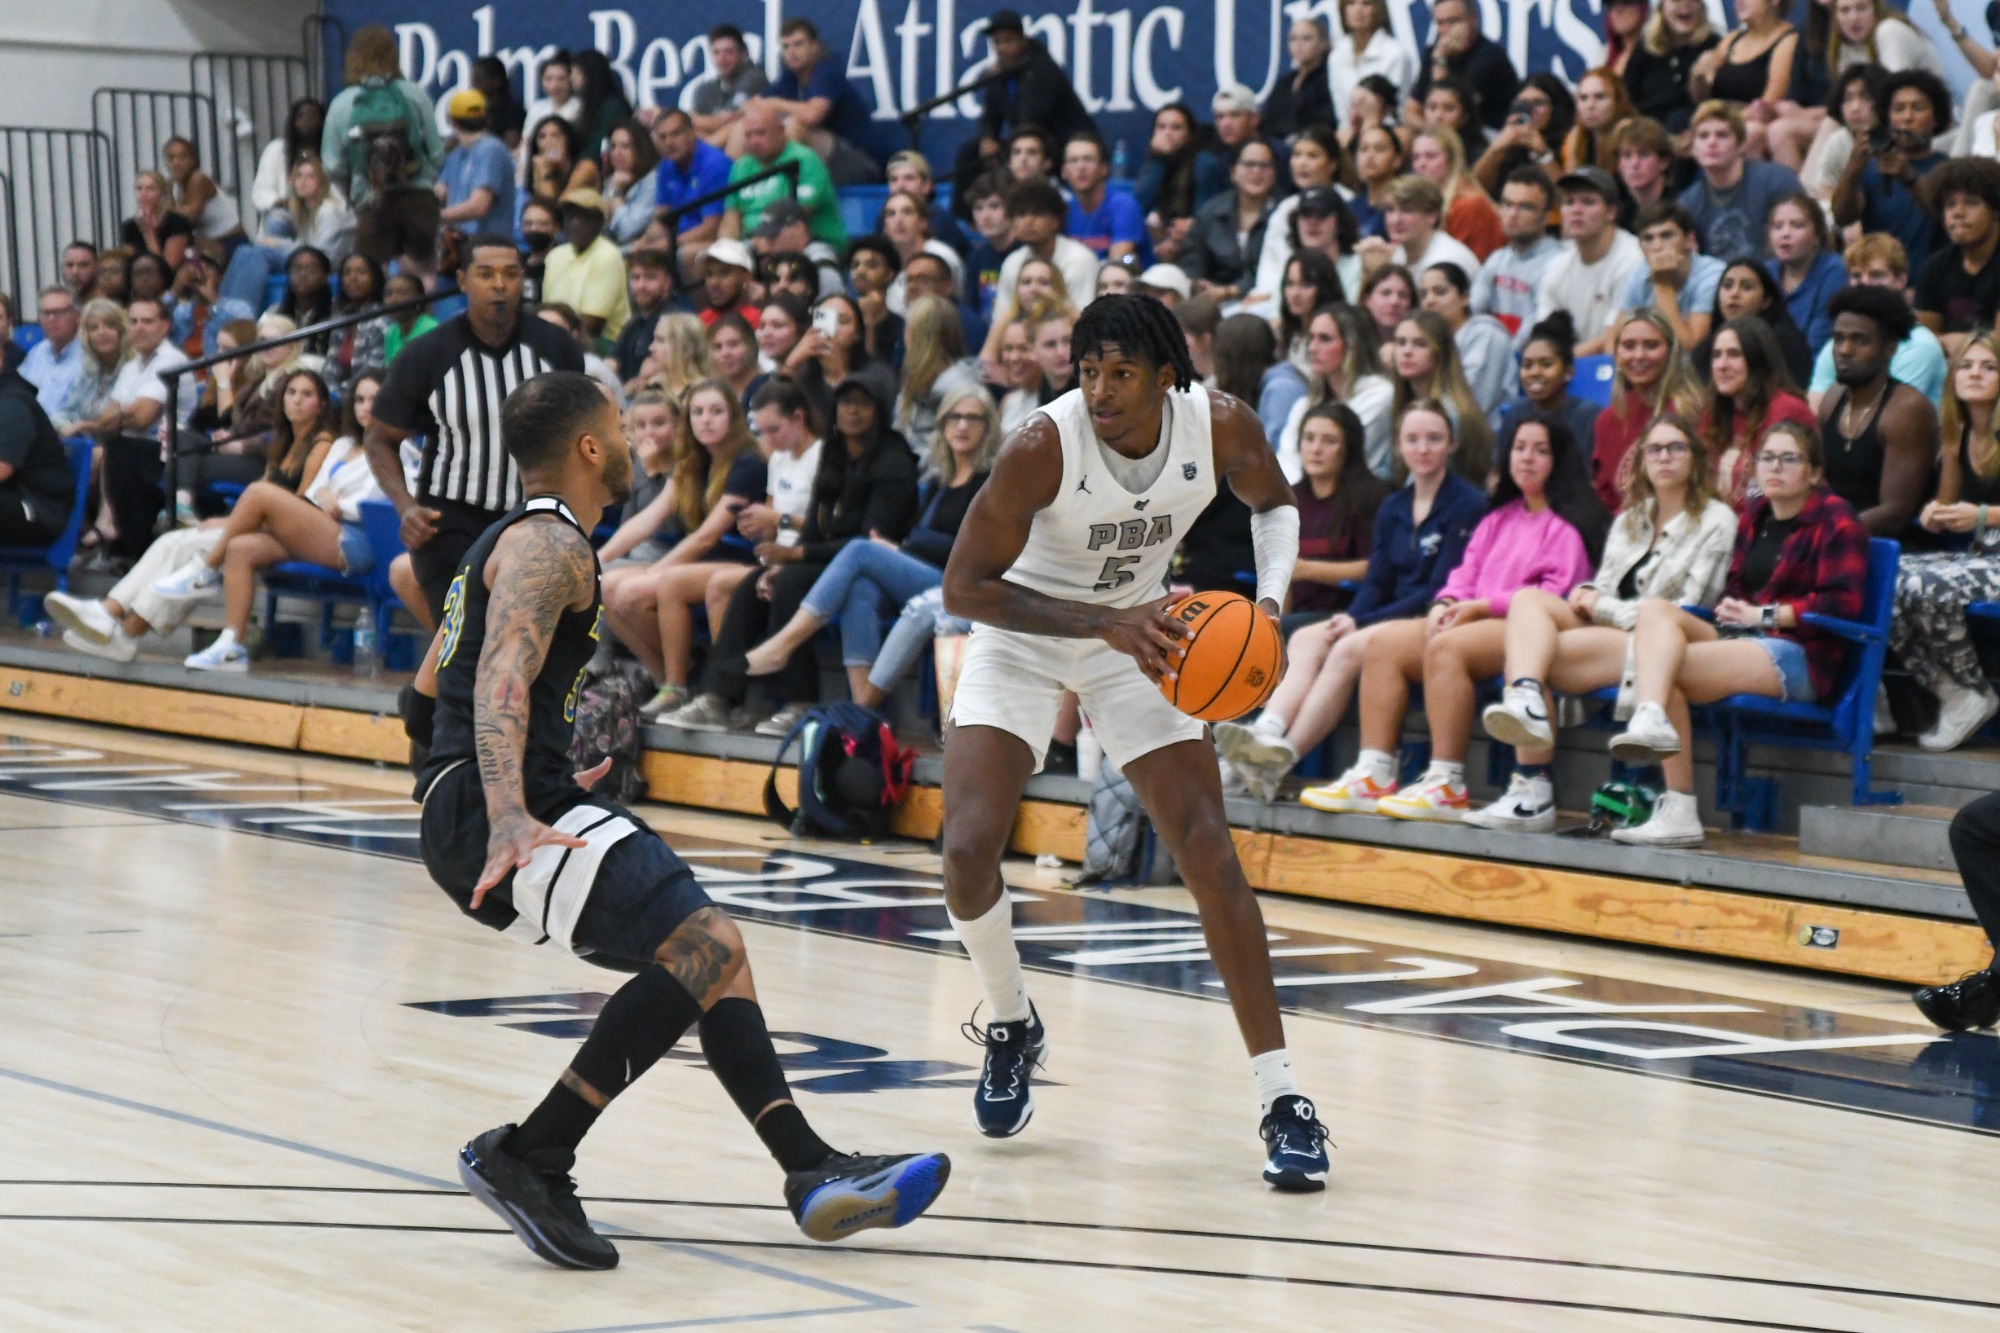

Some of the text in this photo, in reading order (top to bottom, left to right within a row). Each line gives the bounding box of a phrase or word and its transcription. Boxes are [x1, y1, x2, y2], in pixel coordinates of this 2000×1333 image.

[588, 0, 784, 112] Bea
[1087, 514, 1172, 551] PBA
[1093, 555, 1141, 592] 5
